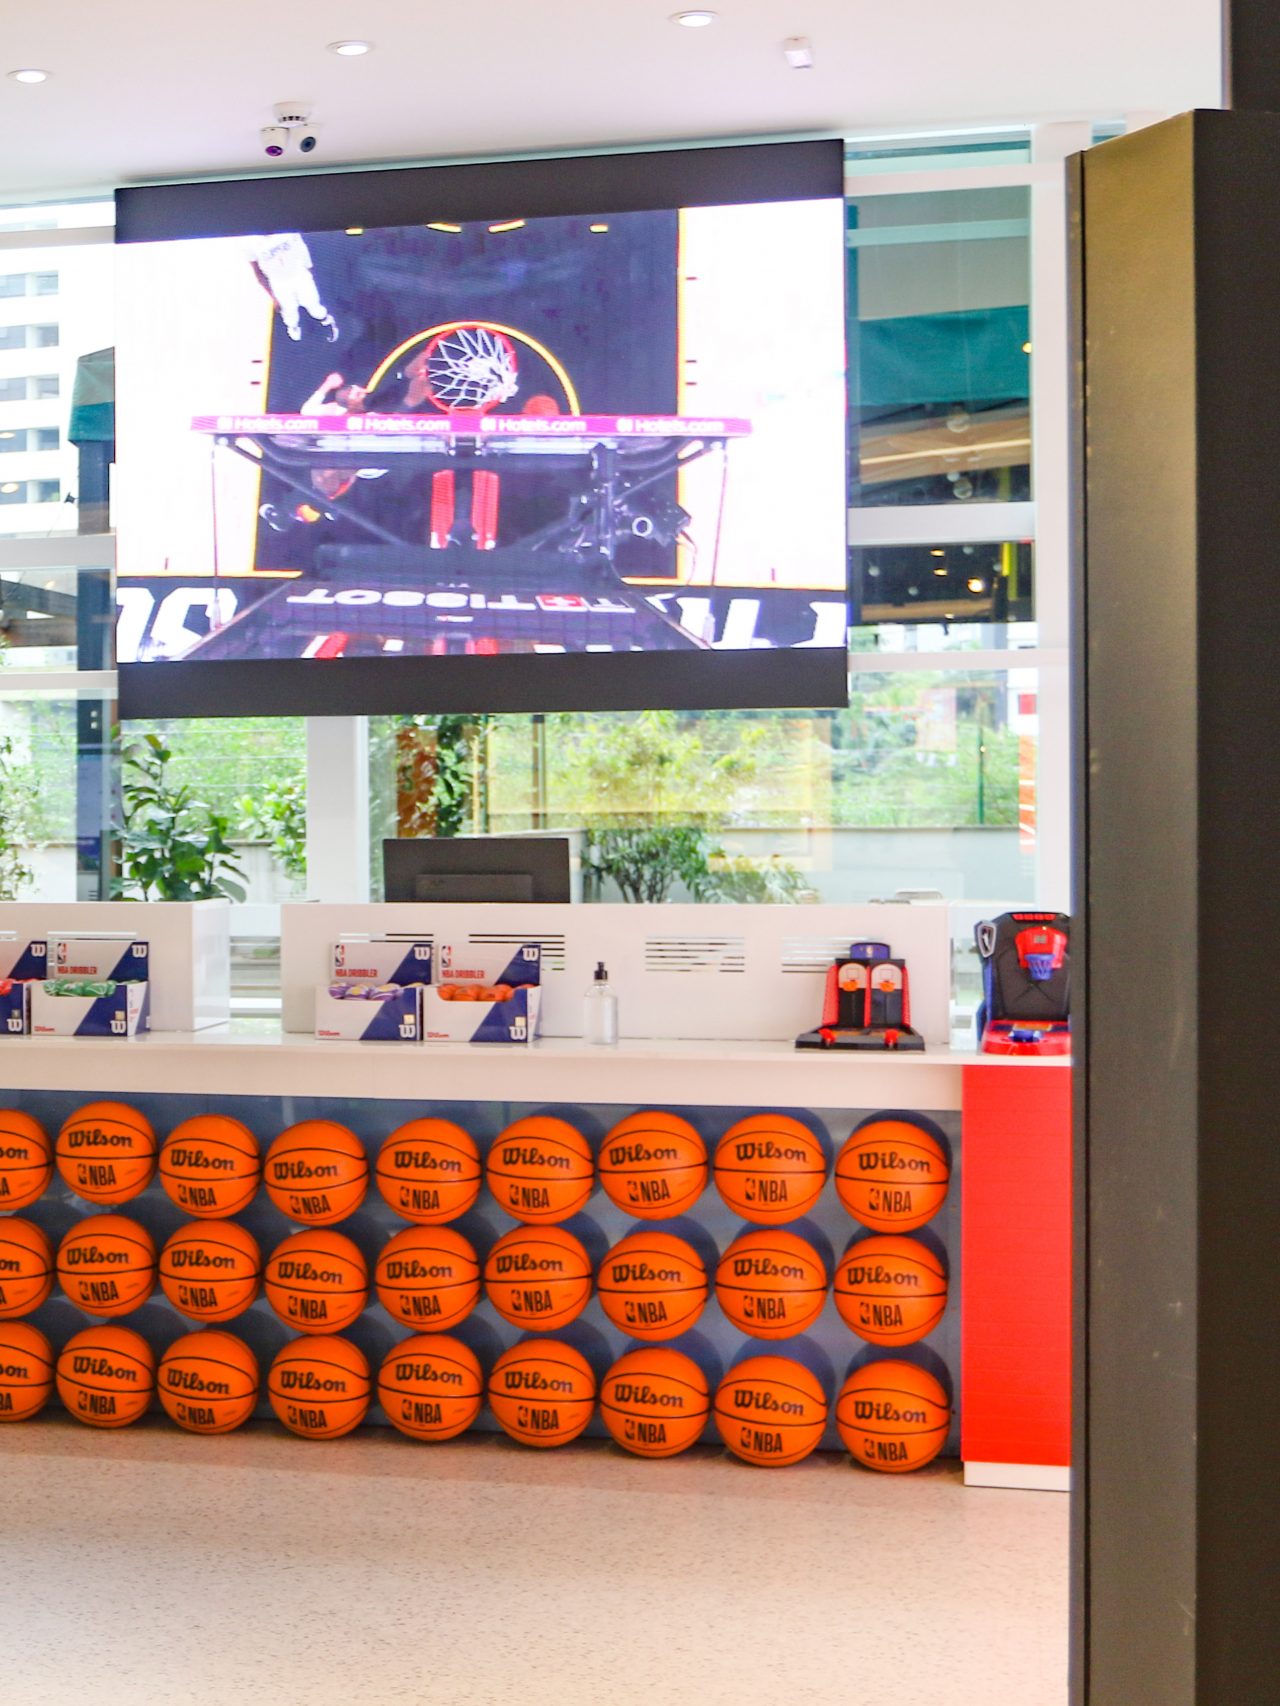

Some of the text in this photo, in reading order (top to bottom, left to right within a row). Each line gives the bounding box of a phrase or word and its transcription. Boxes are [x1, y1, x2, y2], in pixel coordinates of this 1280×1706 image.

[365, 418, 450, 431] Hotels.com
[499, 418, 587, 432] Hotels.com
[635, 418, 724, 432] Hotels.com
[68, 1129, 132, 1148] Wilson
[170, 1149, 235, 1171] Wilson
[394, 1150, 462, 1173] Wilson
[503, 1147, 570, 1169] Wilson
[610, 1144, 677, 1166] Wilson
[736, 1142, 807, 1163] Wilson
[858, 1152, 931, 1173] Wilson
[88, 1165, 116, 1186] NBA
[274, 1161, 338, 1180] Wilson
[189, 1187, 217, 1206] NBA
[412, 1189, 440, 1210] NBA
[522, 1188, 550, 1208] NBA
[641, 1179, 670, 1202] NBA
[759, 1180, 788, 1202] NBA
[882, 1190, 912, 1212] NBA
[302, 1195, 331, 1215] NBA
[67, 1247, 129, 1265] Wilson
[171, 1250, 235, 1269] Wilson
[496, 1253, 563, 1273] Wilson
[278, 1261, 342, 1285] Wilson
[386, 1261, 453, 1279] Wilson
[613, 1264, 682, 1283] Wilson
[734, 1258, 804, 1279] Wilson
[848, 1267, 918, 1286] Wilson
[91, 1281, 119, 1301] NBA
[190, 1287, 218, 1308] NBA
[524, 1290, 553, 1312] NBA
[299, 1299, 327, 1319] NBA
[412, 1295, 442, 1316] NBA
[638, 1301, 667, 1323] NBA
[757, 1298, 786, 1320] NBA
[873, 1304, 903, 1326] NBA
[73, 1356, 137, 1382] Wilson
[395, 1363, 463, 1386] Wilson
[167, 1368, 230, 1394] Wilson
[280, 1370, 347, 1393] Wilson
[505, 1371, 573, 1393] Wilson
[90, 1395, 116, 1415] NBA
[615, 1384, 684, 1408] Wilson
[734, 1390, 804, 1416] Wilson
[188, 1406, 216, 1425] NBA
[299, 1409, 327, 1428] NBA
[414, 1403, 442, 1424] NBA
[530, 1409, 559, 1430] NBA
[854, 1400, 927, 1423] Wilson
[638, 1421, 667, 1443] NBA
[754, 1431, 783, 1452] NBA
[878, 1442, 908, 1461] NBA
